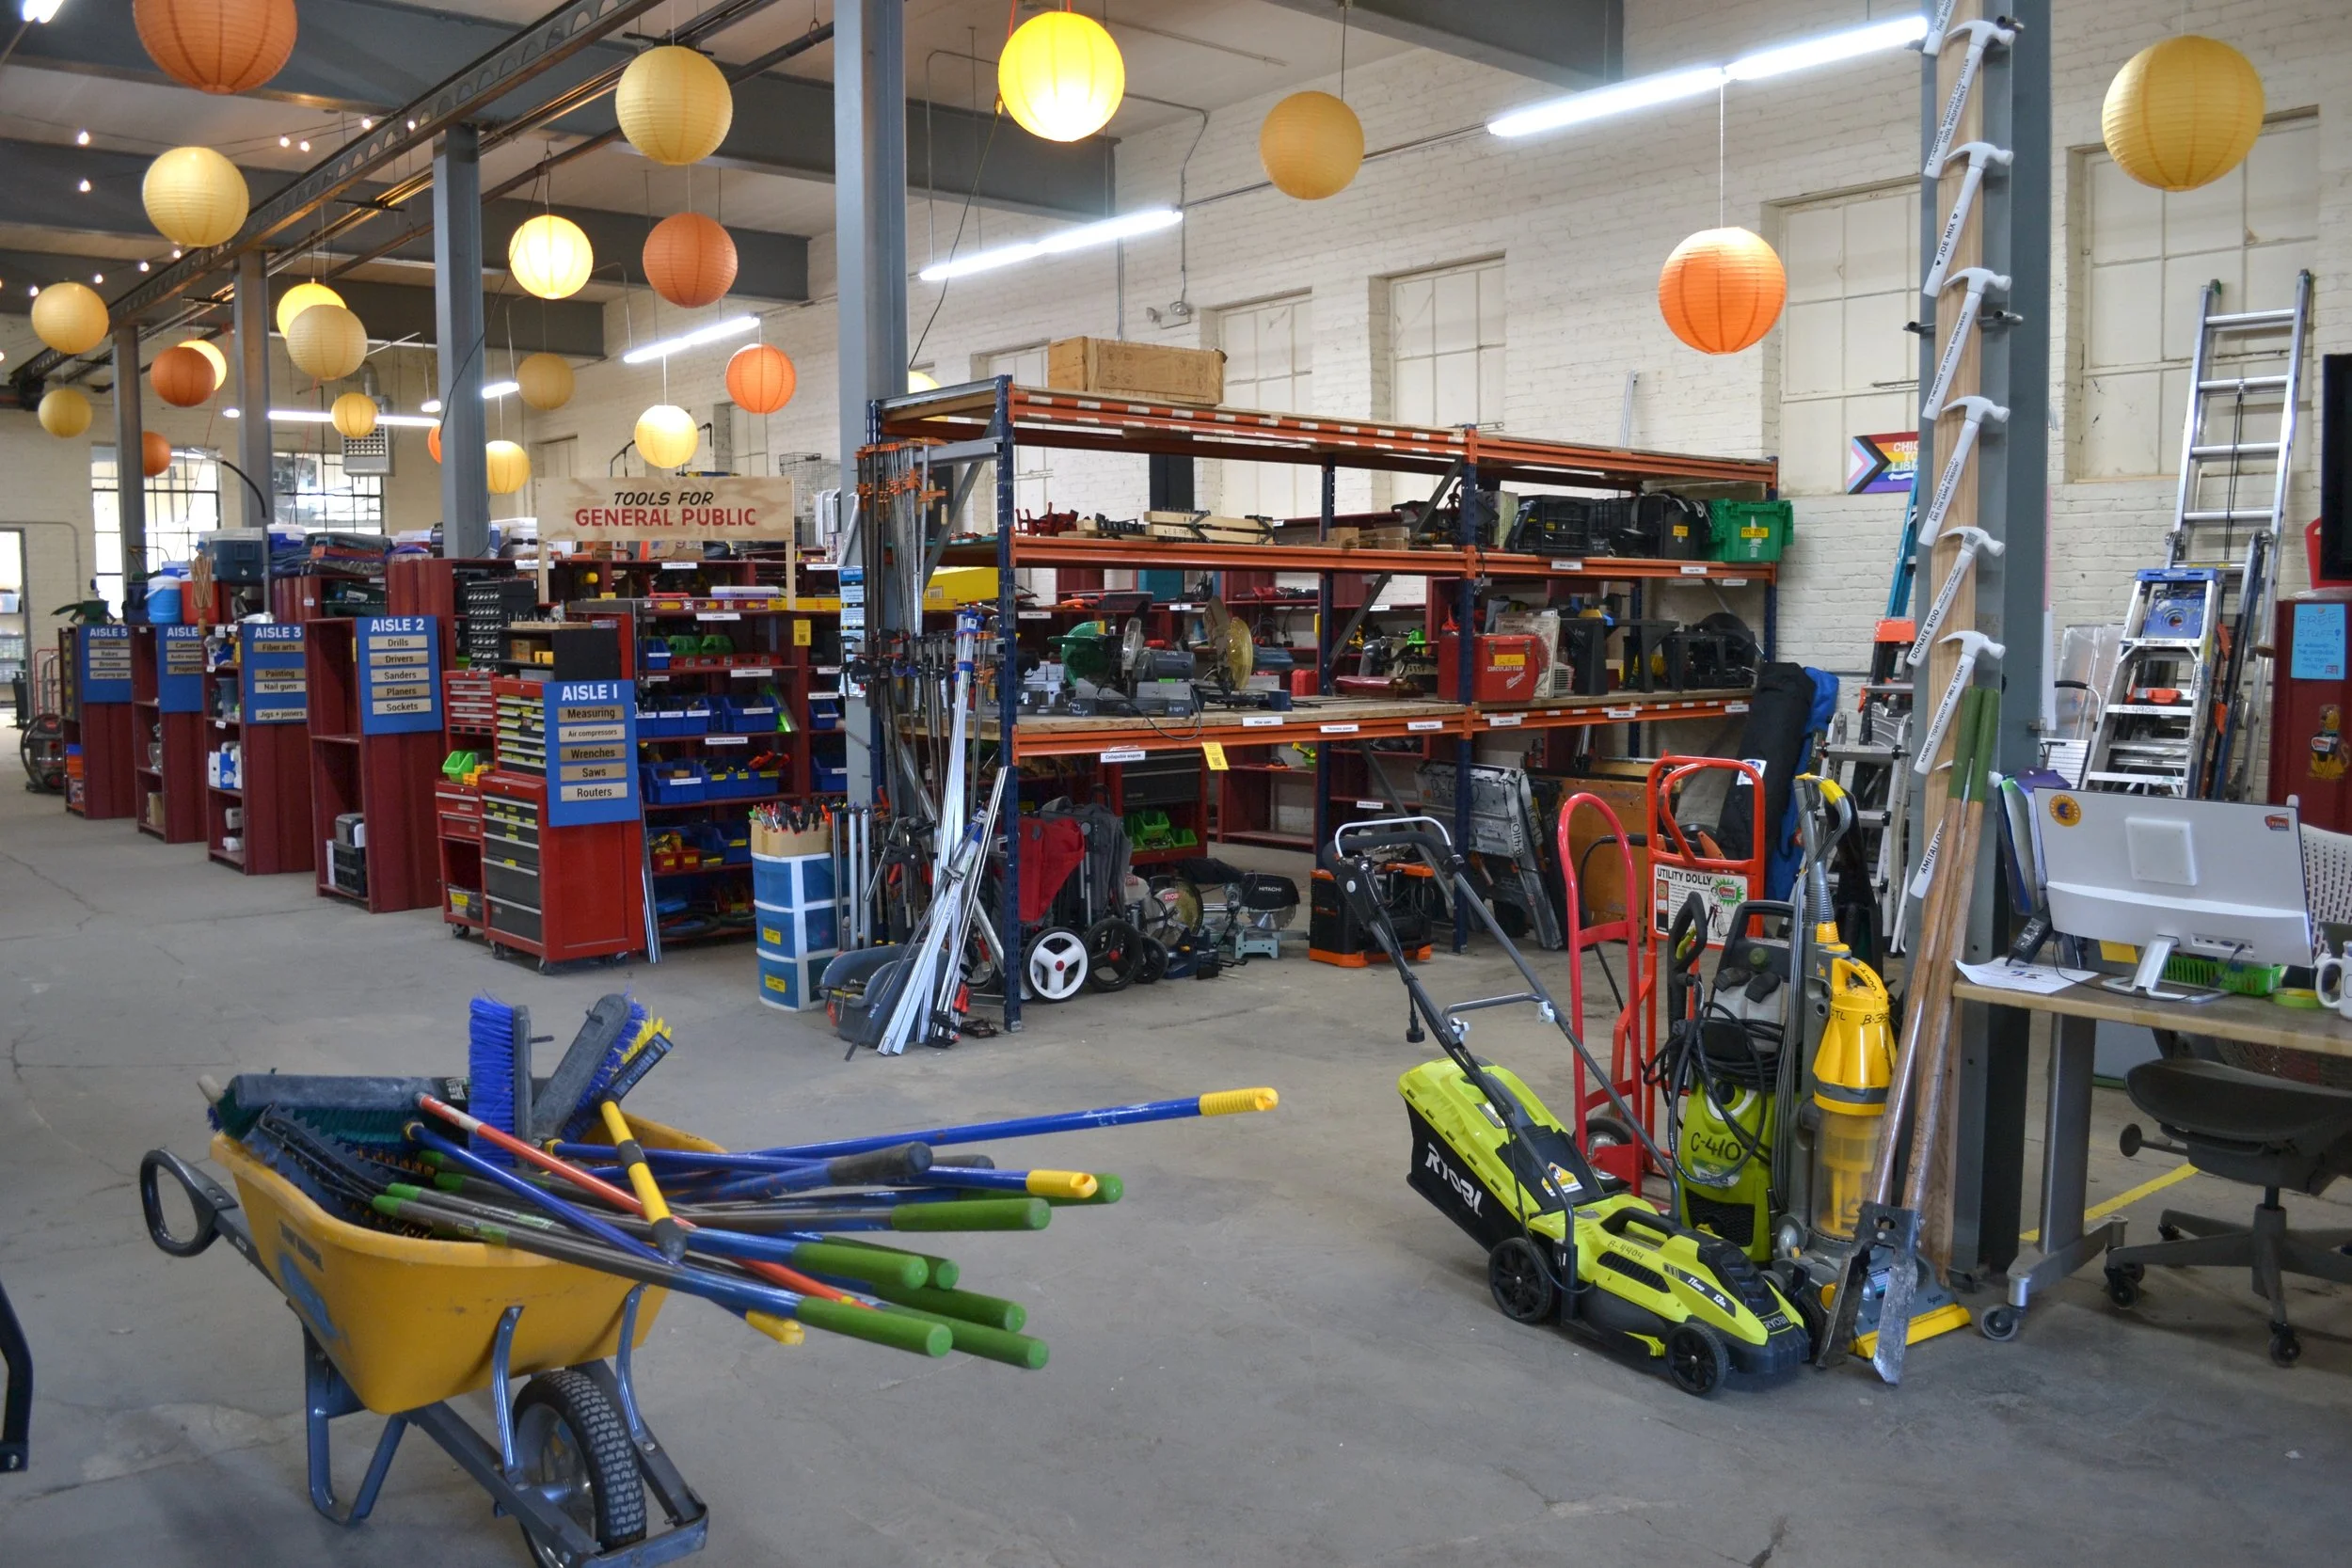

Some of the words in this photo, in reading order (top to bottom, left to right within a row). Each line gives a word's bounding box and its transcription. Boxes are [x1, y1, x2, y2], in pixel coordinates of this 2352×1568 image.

[1942, 124, 1952, 143] TOOL
[1947, 85, 1966, 126] PROFICIENCY
[1939, 240, 1949, 257] JOE
[1945, 223, 1956, 239] MIX
[1931, 373, 1944, 399] MEMORY
[1944, 346, 1954, 364] LYNDA
[1951, 311, 1968, 345] ROSENBERG
[614, 491, 671, 506] TOOLS
[677, 491, 714, 506] FOR
[1941, 485, 1950, 500] SAME
[575, 508, 674, 527] GENERAL
[681, 507, 756, 527] PUBLIC
[371, 619, 411, 632] AISLE
[416, 618, 424, 631] 2
[89, 627, 119, 637] AISLE
[121, 627, 128, 637] 5
[167, 626, 199, 638] AISLE
[255, 627, 290, 639] AISLE
[294, 626, 302, 638] 3
[1911, 628, 1931, 659] DONATE
[1927, 609, 1940, 629] $100
[388, 639, 409, 647] Drills
[385, 655, 414, 664] Drivers
[265, 670, 295, 678] Painting
[384, 671, 417, 680] Sanders
[386, 688, 417, 696] Planers
[562, 684, 608, 702] AISLE
[386, 703, 419, 711] Sockets
[567, 707, 615, 720] Measuring
[281, 710, 304, 719] joiners
[579, 729, 618, 738] compressors
[570, 749, 615, 759] Wrenches
[1920, 739, 1933, 763] MANUEL
[582, 768, 607, 778] Saws
[577, 787, 612, 798] Routers
[1920, 845, 1938, 874] AMITAI
[1657, 867, 1684, 882] UTILITY
[1685, 873, 1712, 886] DOLLY
[1691, 1132, 1741, 1161] C-410
[1425, 1142, 1483, 1219] RYOBI
[1763, 1315, 1789, 1330] RYOBI
